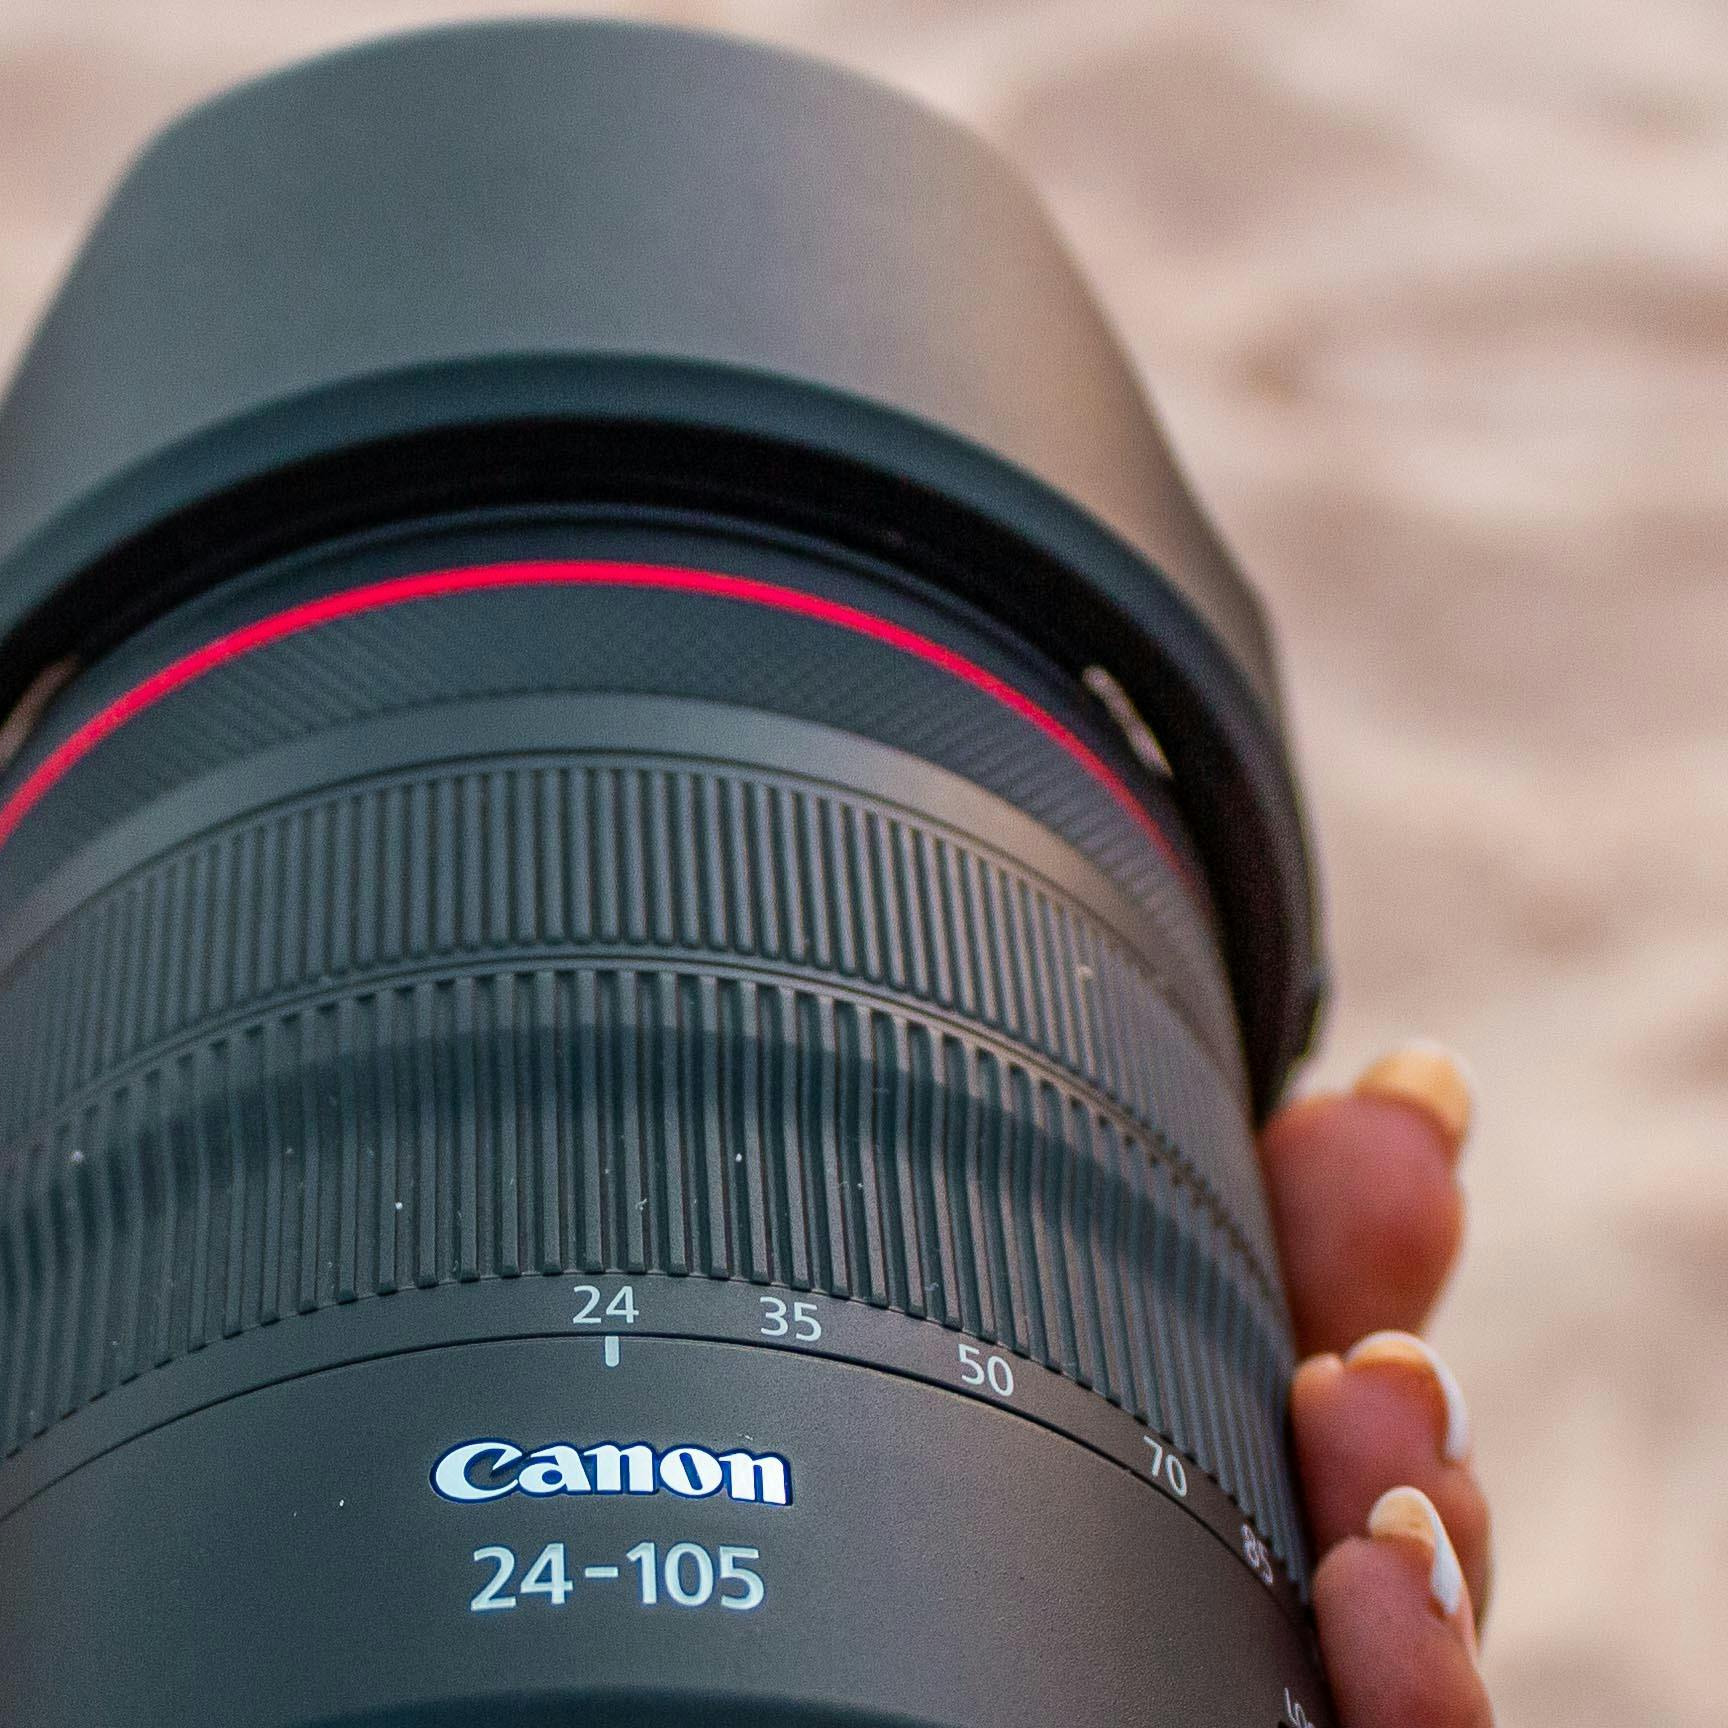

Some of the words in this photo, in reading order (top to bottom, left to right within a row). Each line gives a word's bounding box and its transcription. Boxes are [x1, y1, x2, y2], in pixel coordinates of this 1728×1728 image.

[572, 1284, 640, 1325] 24
[759, 1296, 823, 1343] 35
[958, 1342, 1015, 1398] 50
[1142, 1434, 1188, 1498] 70
[432, 1439, 791, 1506] Canon
[470, 1541, 767, 1613] 24-105
